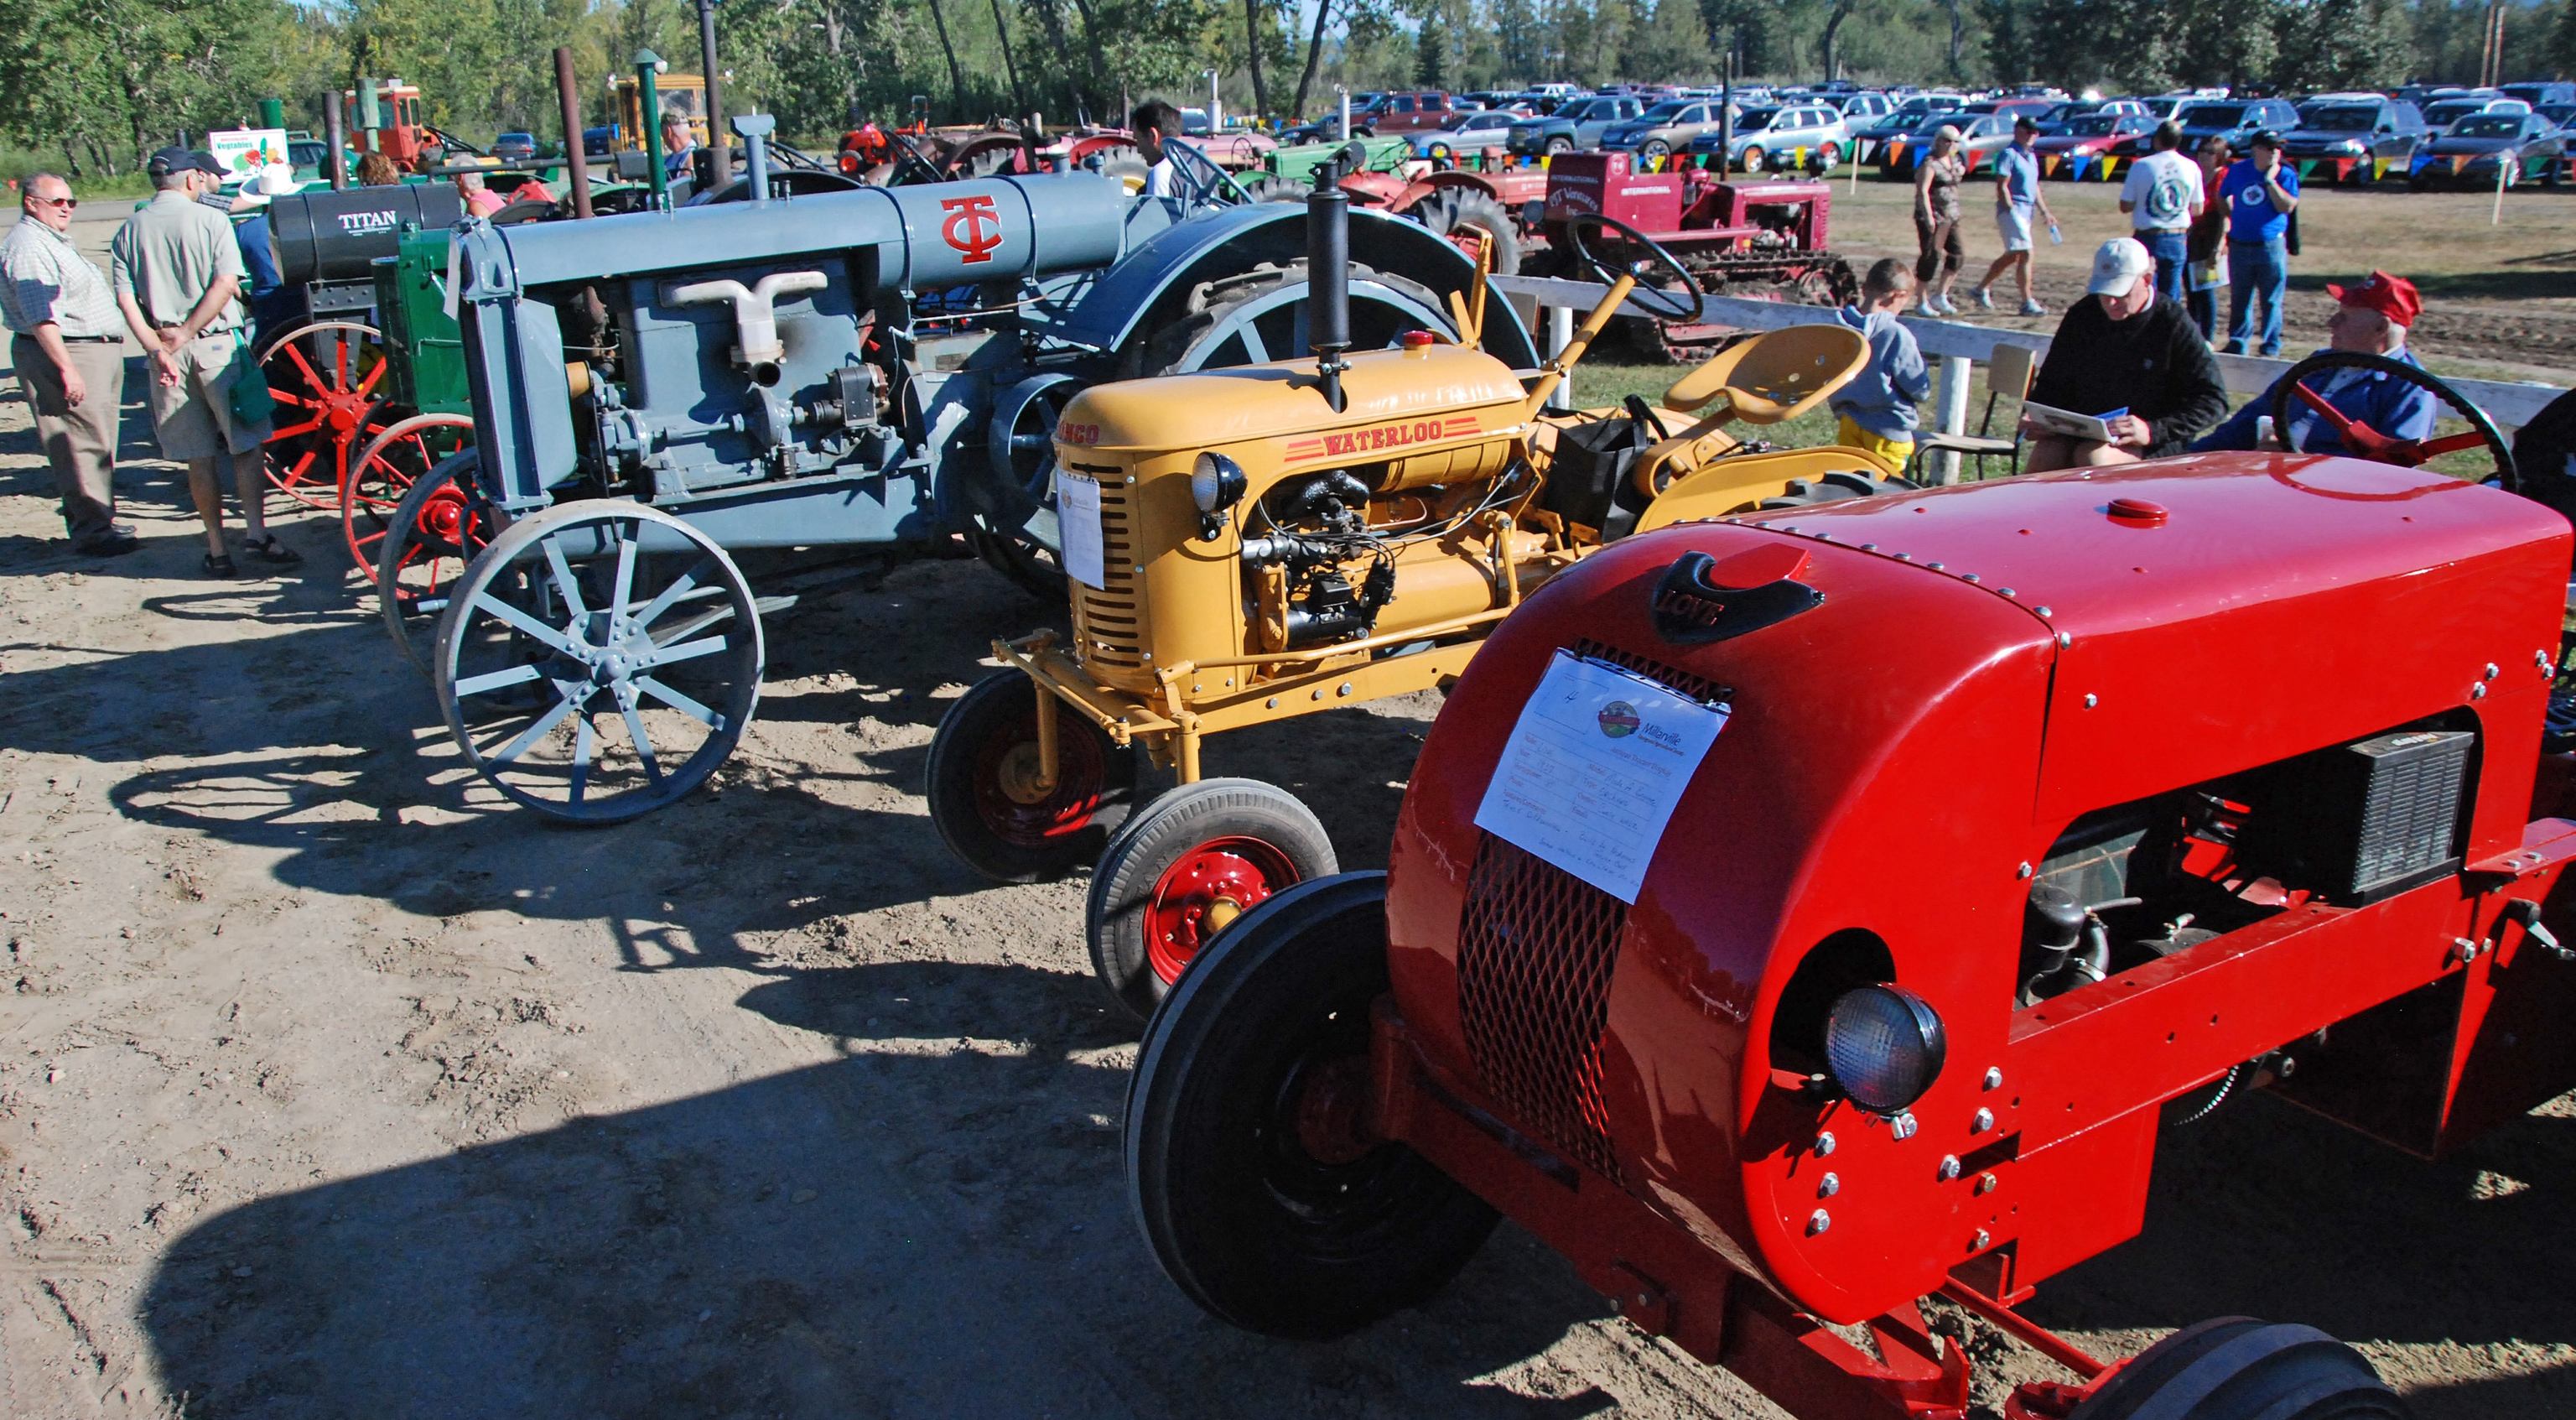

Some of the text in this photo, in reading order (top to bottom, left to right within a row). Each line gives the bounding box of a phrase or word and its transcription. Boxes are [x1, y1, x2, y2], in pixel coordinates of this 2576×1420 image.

[338, 211, 397, 229] TITAN
[1323, 421, 1441, 455] WATERLOO
[1643, 723, 1681, 746] Millarville
